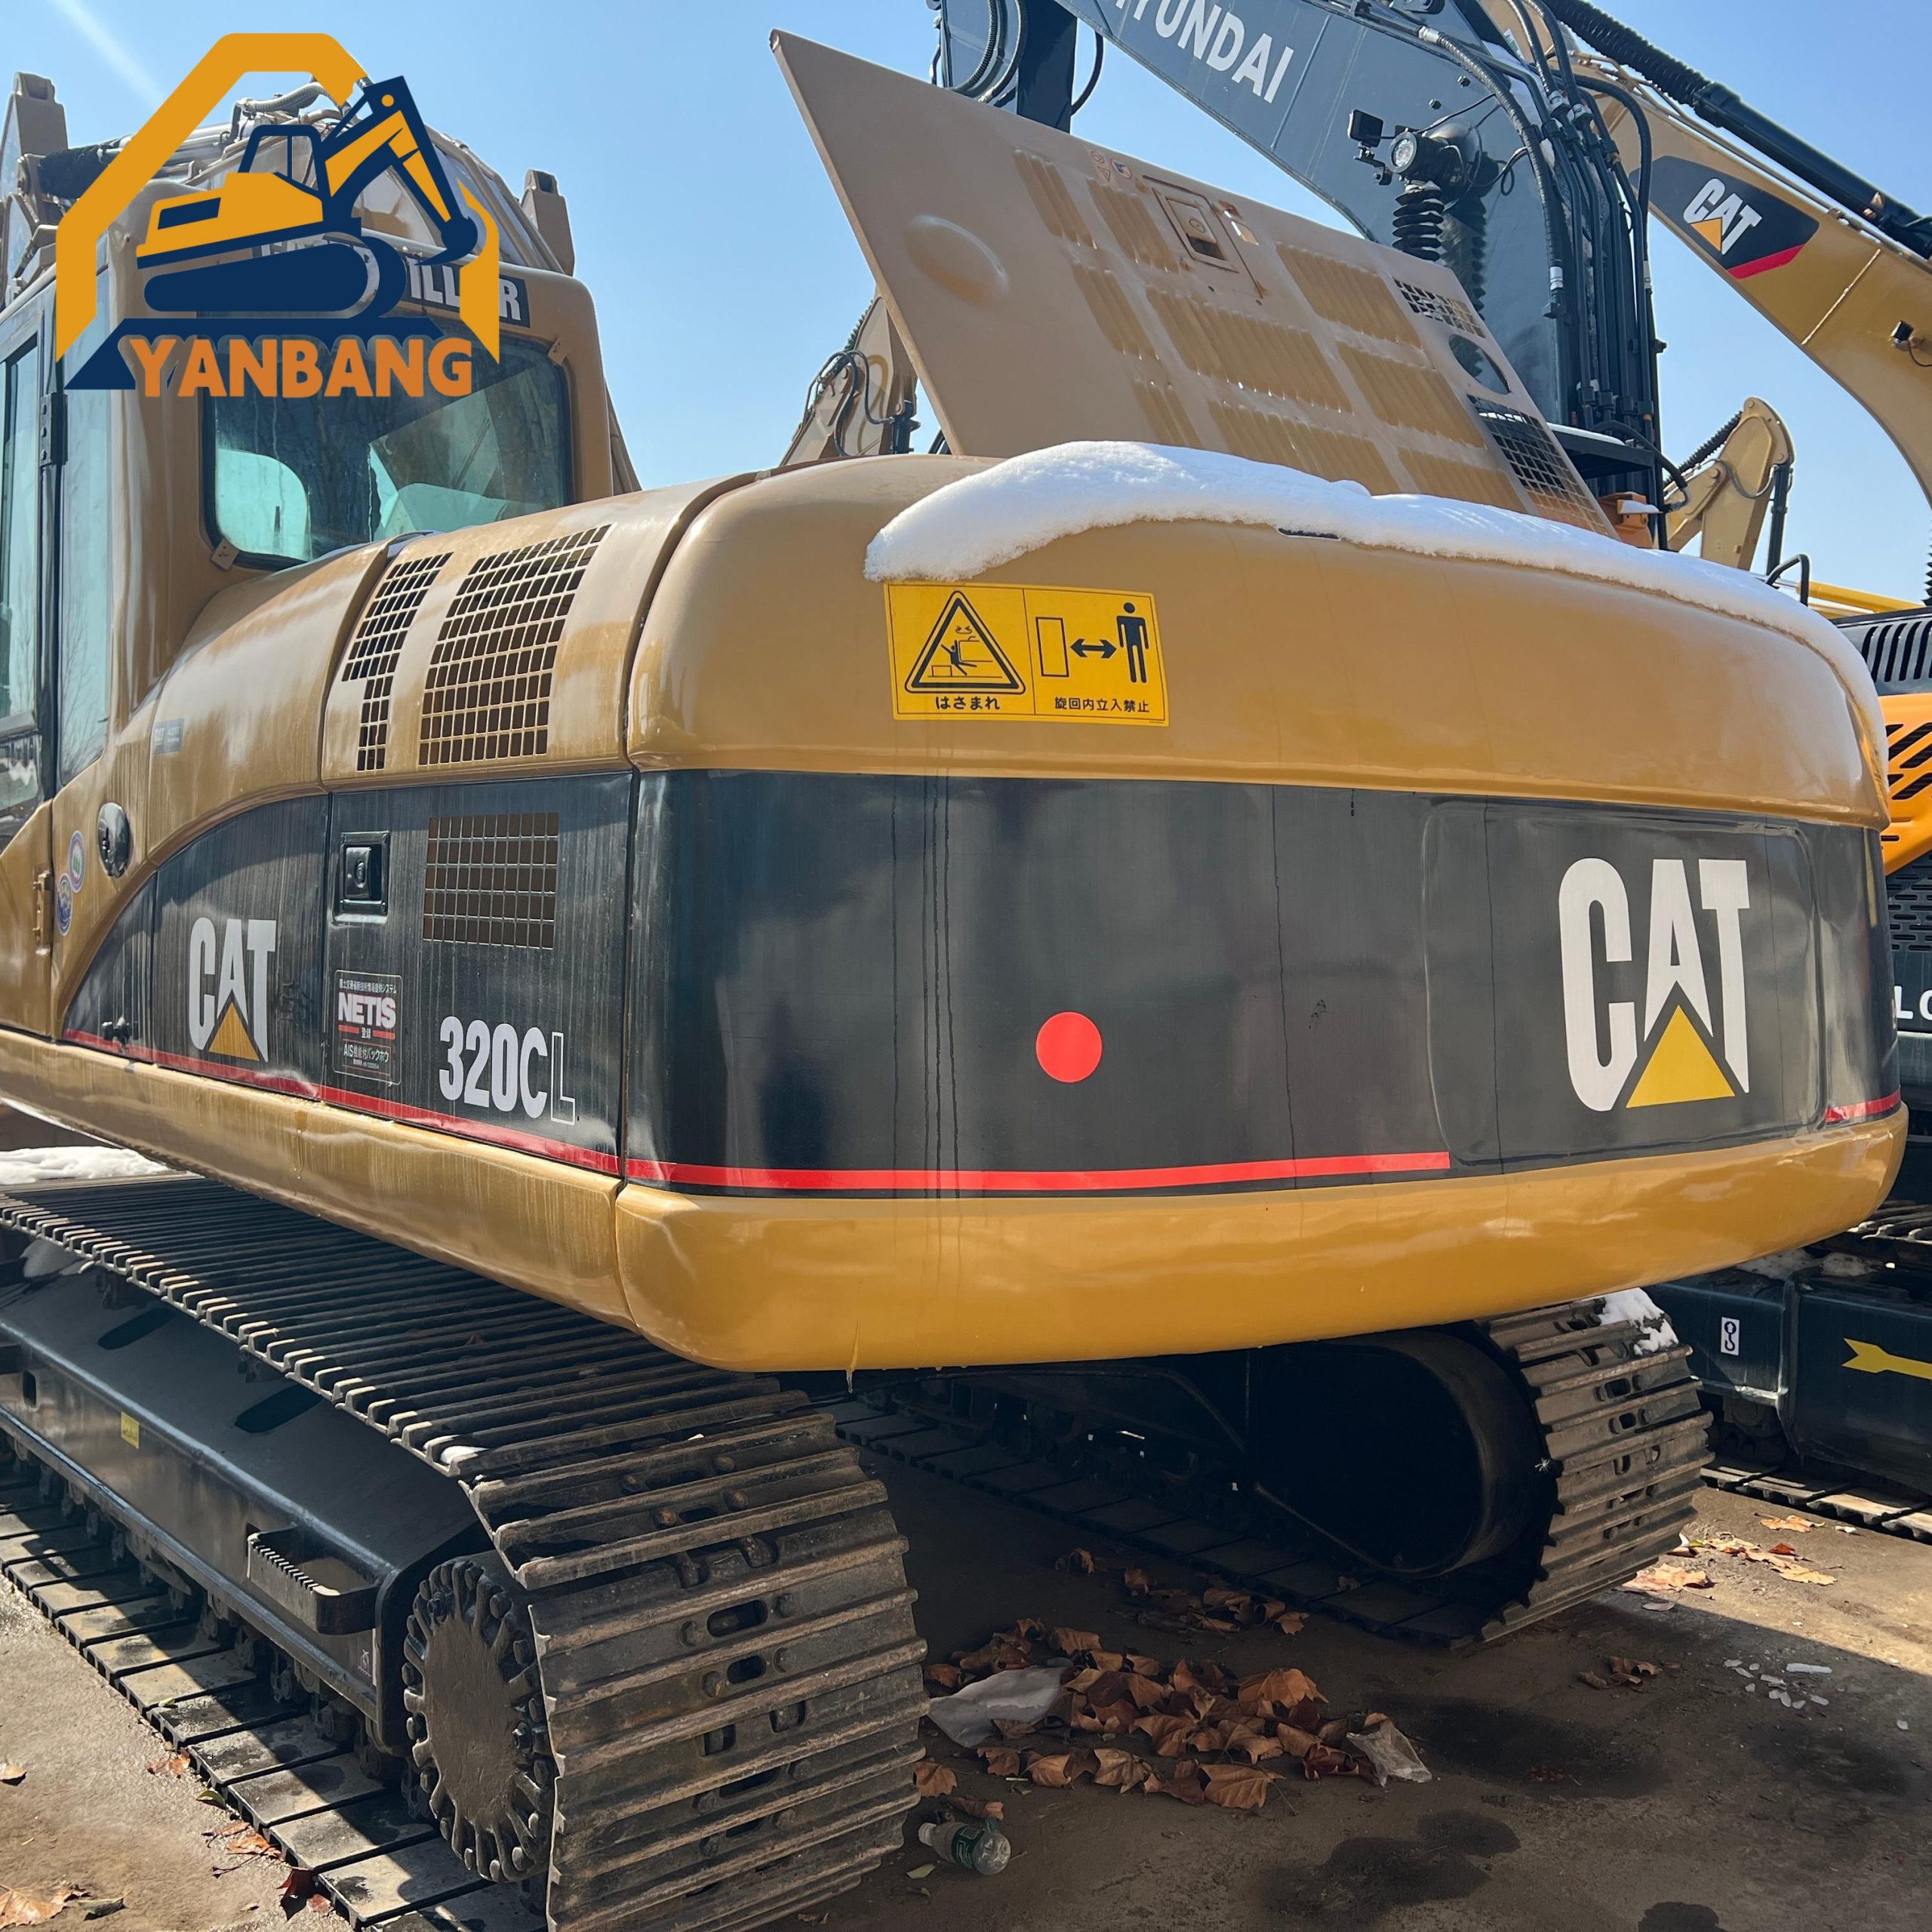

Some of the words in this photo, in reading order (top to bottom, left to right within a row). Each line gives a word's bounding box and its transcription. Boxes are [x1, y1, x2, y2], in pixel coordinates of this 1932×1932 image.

[1683, 178, 1763, 255] CAT
[935, 696, 1000, 710] はさまれ
[1055, 697, 1149, 712] 旋回内立入禁止
[189, 917, 276, 1063] CAT
[338, 992, 396, 1029] NETIS
[1558, 858, 1750, 1112] CAT
